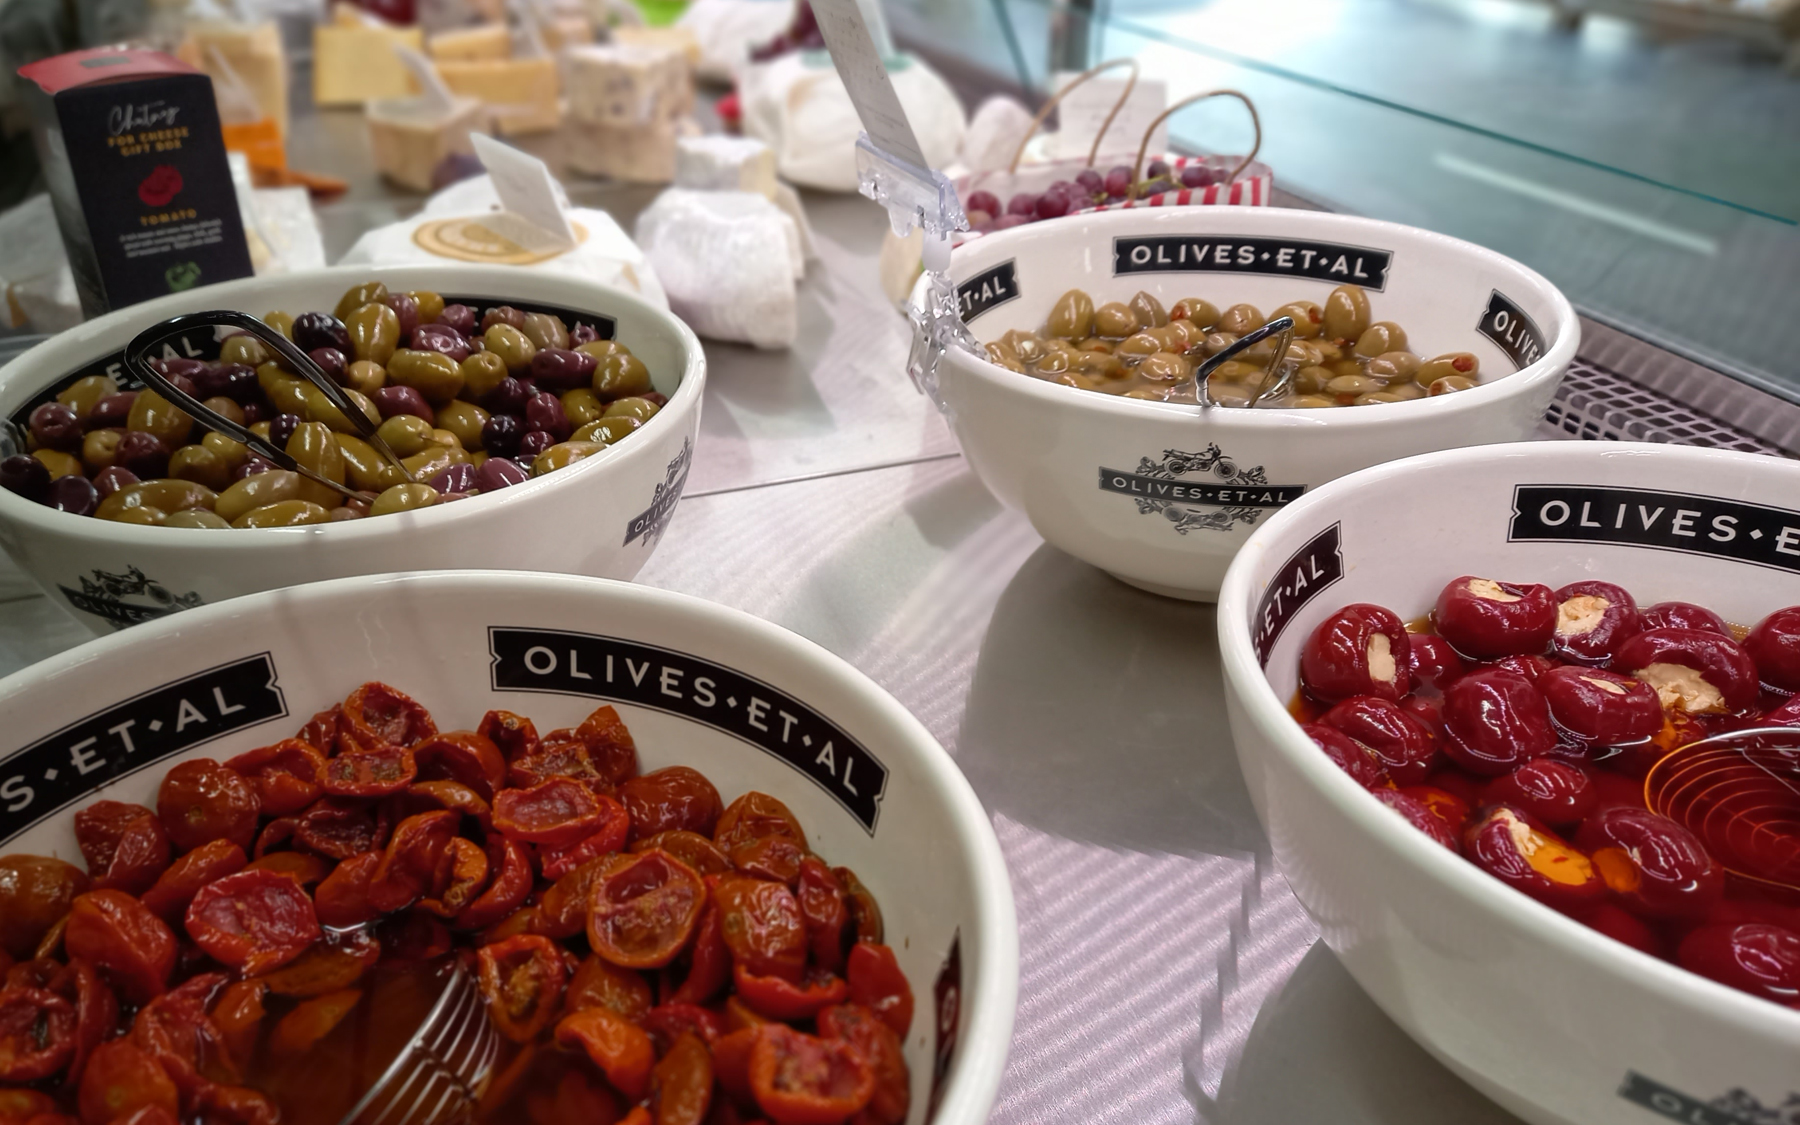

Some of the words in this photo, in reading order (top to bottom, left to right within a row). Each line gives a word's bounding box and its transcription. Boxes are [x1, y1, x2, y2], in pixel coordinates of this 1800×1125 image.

[139, 126, 189, 142] CHEESE
[120, 142, 150, 156] GIFT
[140, 208, 197, 226] TOMATO
[1538, 500, 1739, 542] OLIVES
[524, 646, 717, 708] OLIVES
